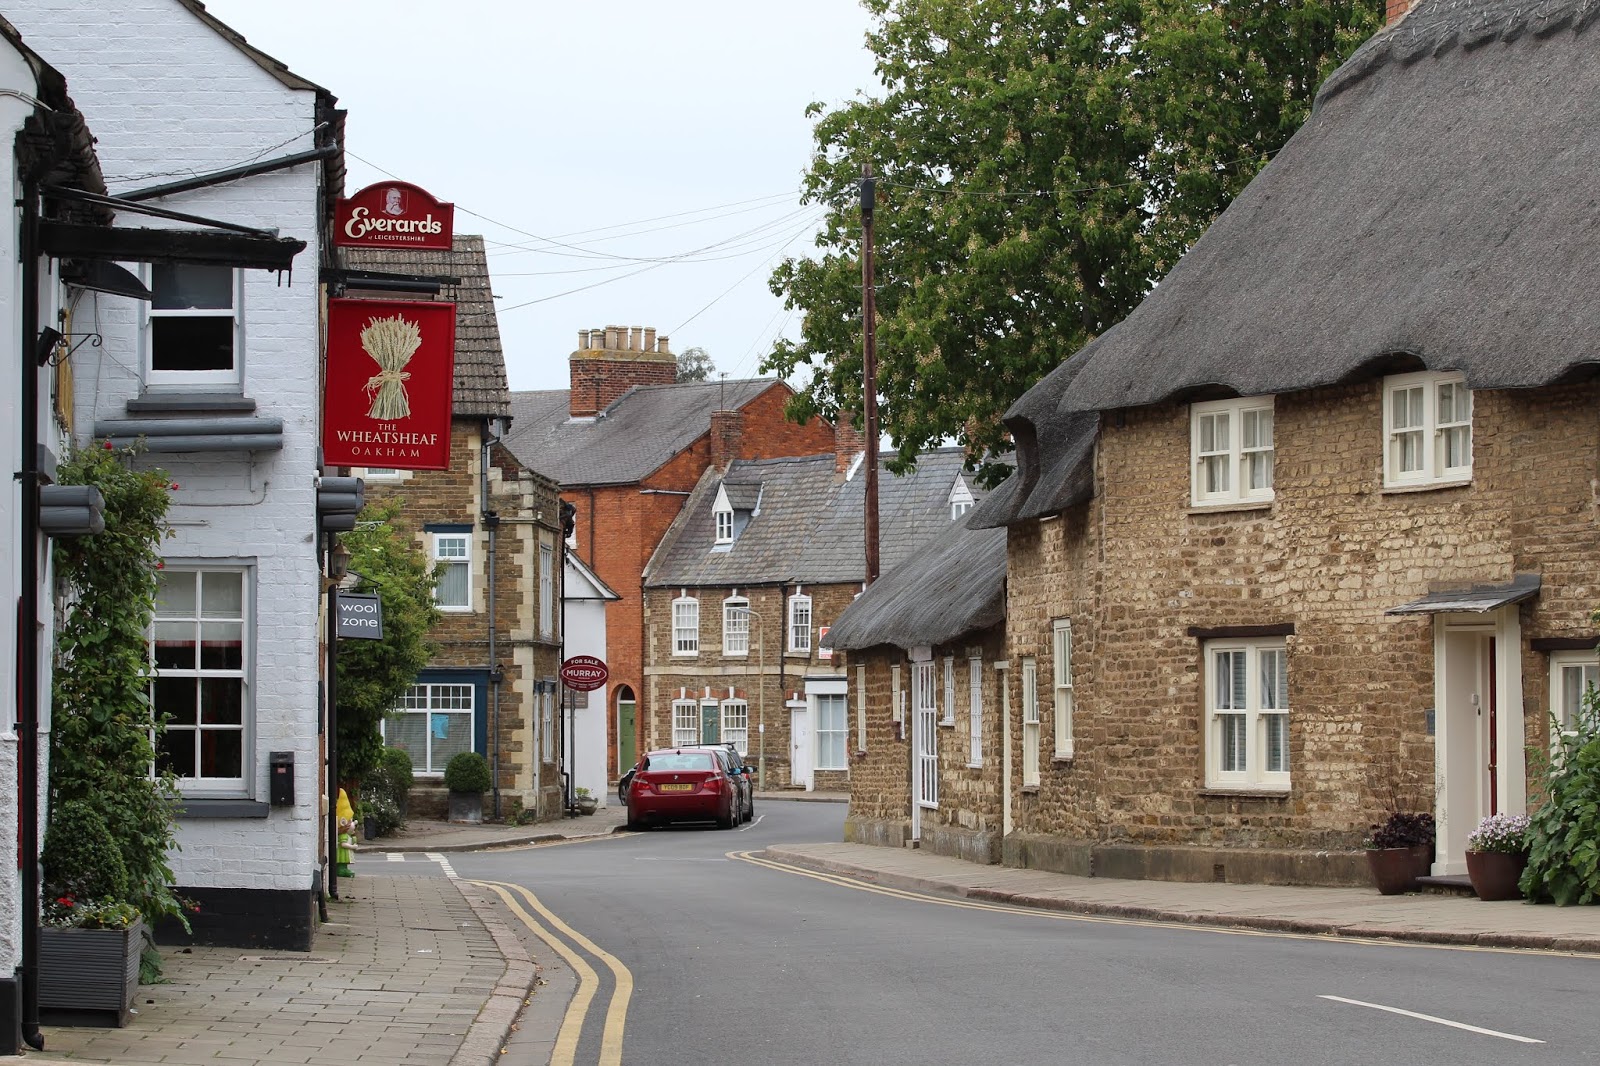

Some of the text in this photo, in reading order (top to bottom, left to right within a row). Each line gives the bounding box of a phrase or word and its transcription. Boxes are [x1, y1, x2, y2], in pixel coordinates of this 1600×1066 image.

[344, 206, 442, 238] Everards
[374, 234, 425, 242] LEICESTERSHIRE
[378, 423, 397, 431] THE
[337, 430, 438, 445] WHEATSHEAF
[351, 446, 420, 457] OAKHAM
[340, 603, 377, 613] wool
[342, 617, 378, 627] zone
[566, 669, 602, 677] MURRAY
